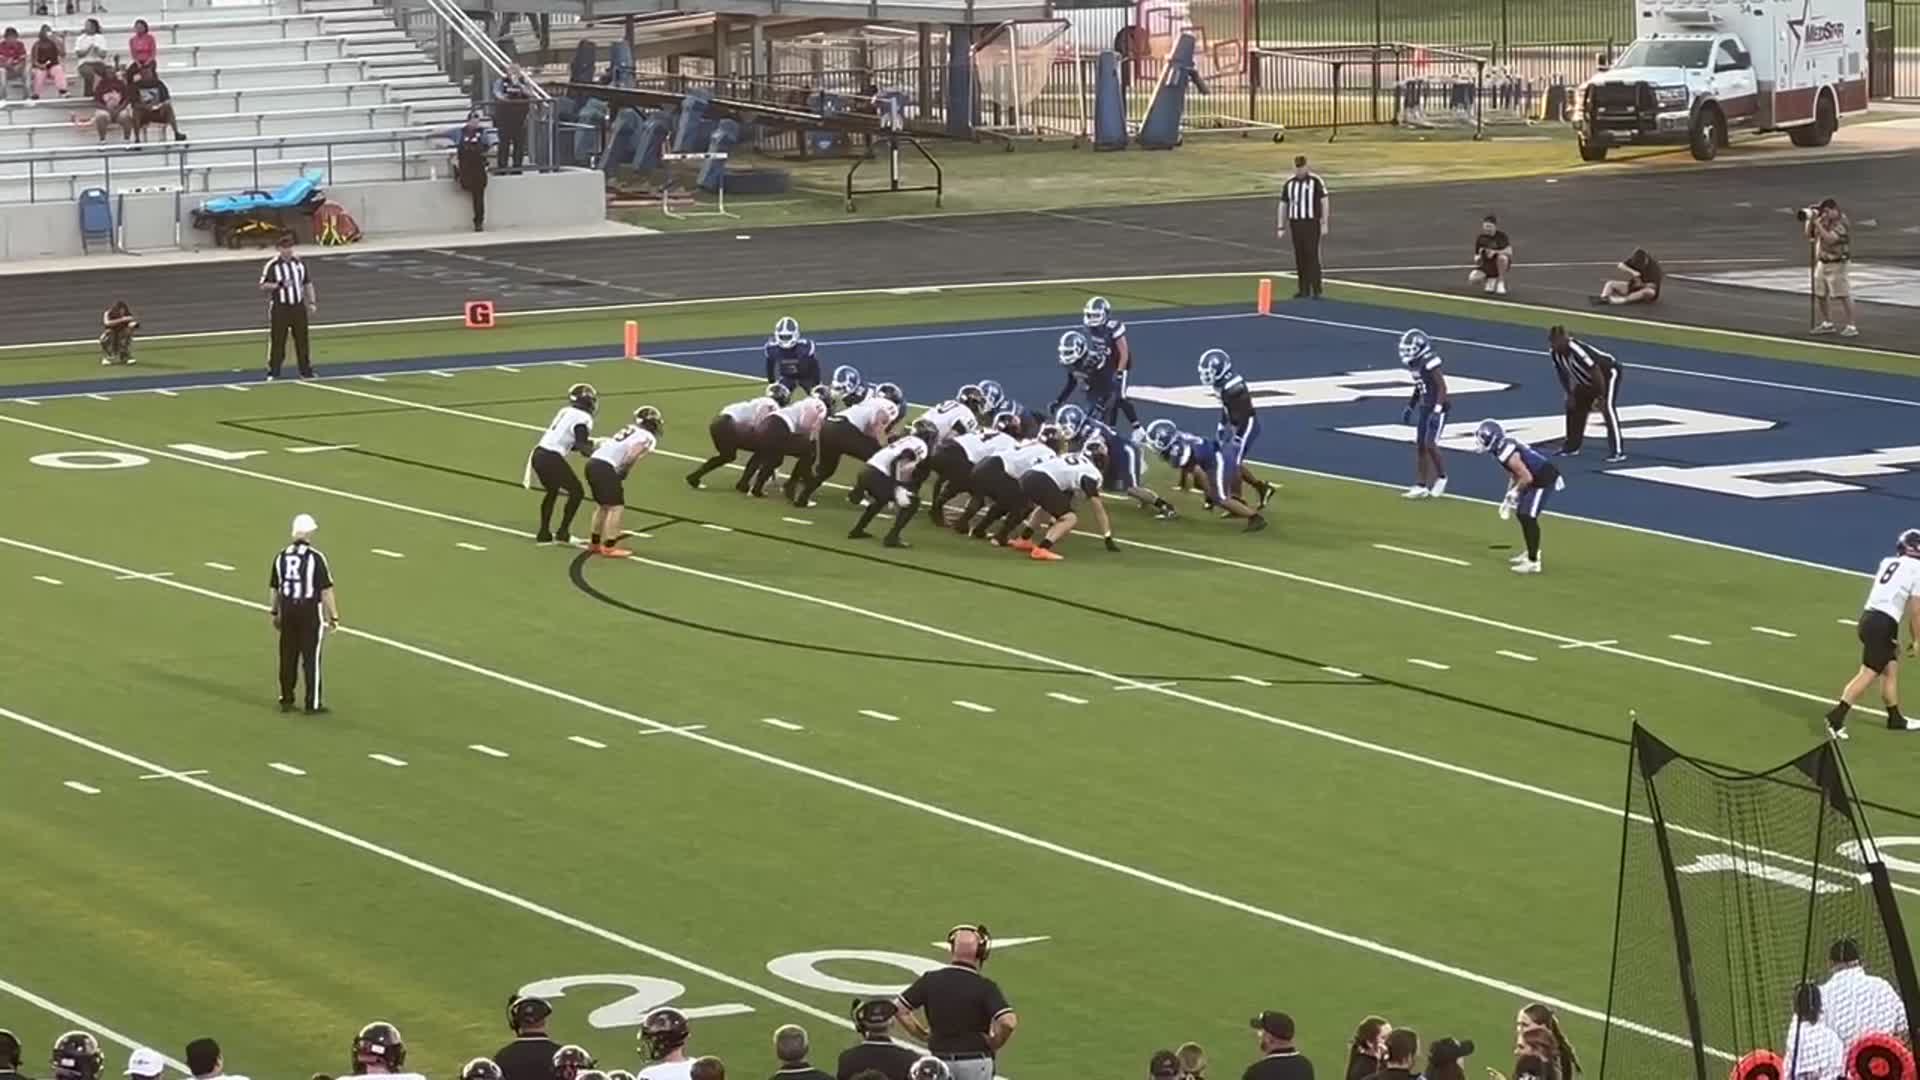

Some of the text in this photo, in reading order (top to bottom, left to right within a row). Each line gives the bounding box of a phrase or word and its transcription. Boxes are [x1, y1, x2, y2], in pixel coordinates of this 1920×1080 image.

[469, 303, 491, 325] G
[284, 555, 301, 579] R
[1879, 561, 1899, 584] 8
